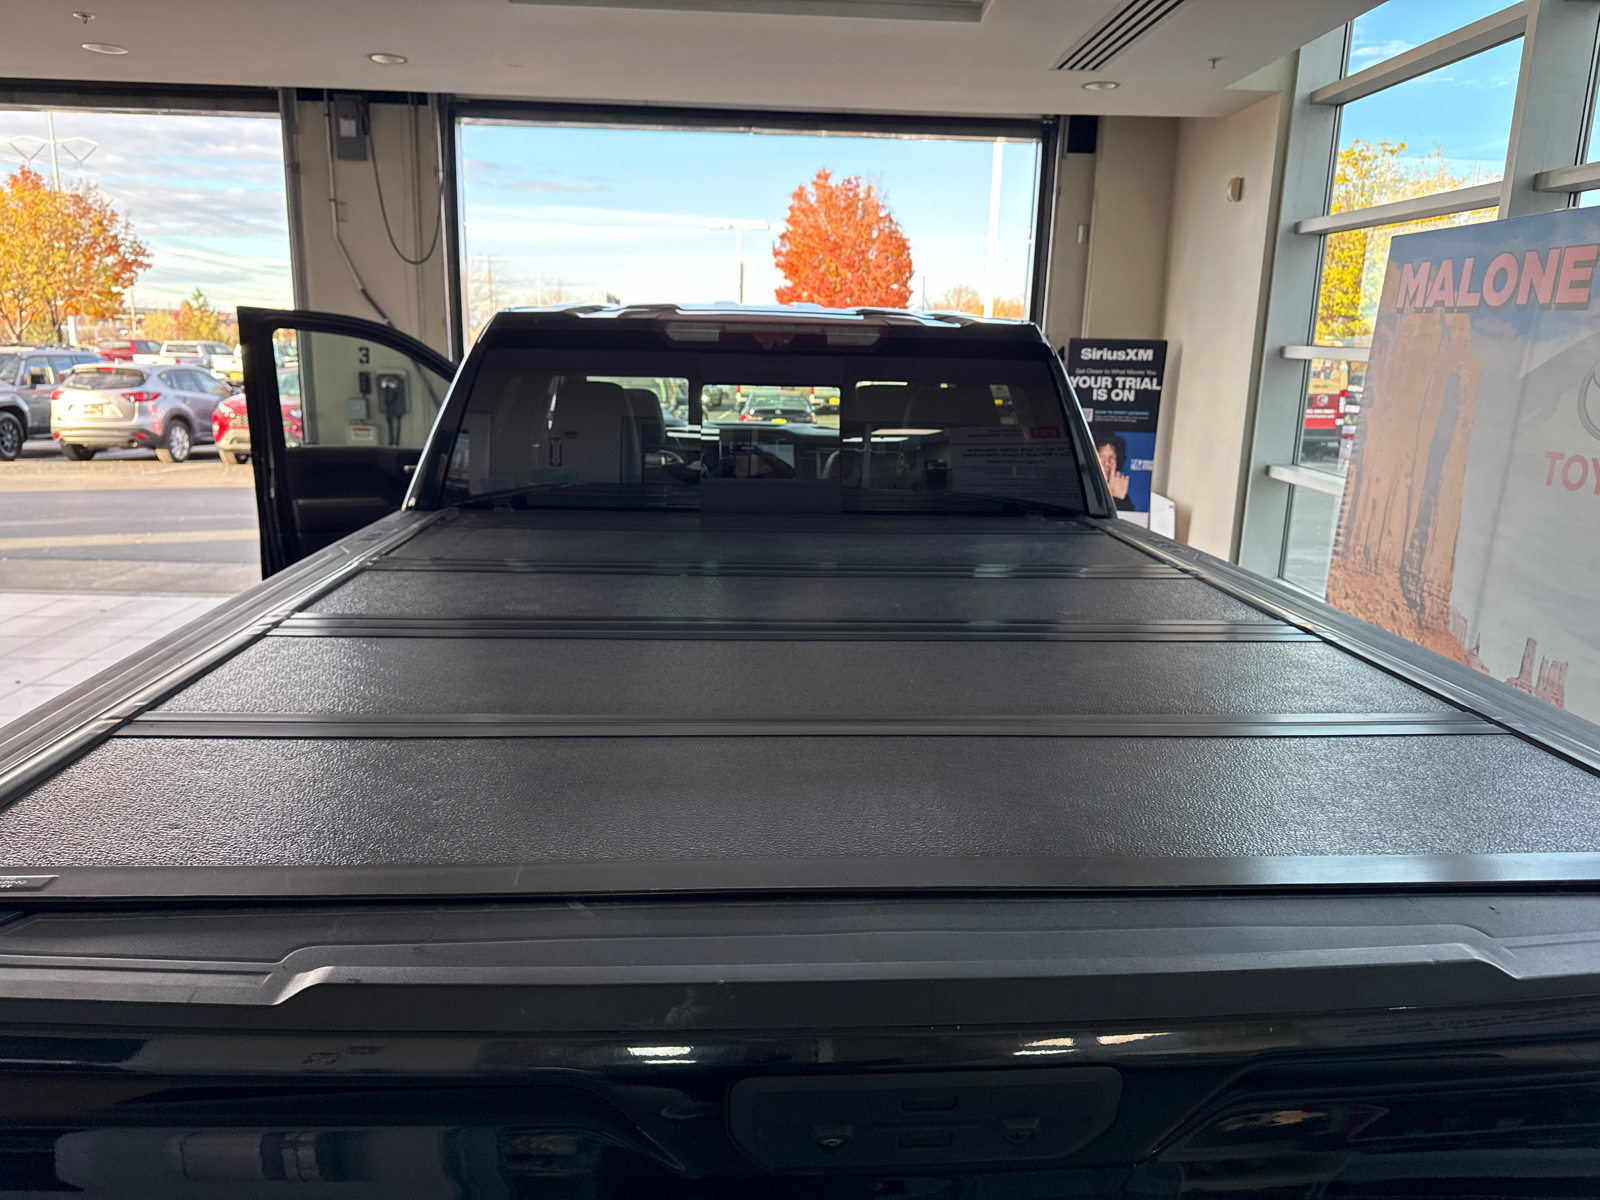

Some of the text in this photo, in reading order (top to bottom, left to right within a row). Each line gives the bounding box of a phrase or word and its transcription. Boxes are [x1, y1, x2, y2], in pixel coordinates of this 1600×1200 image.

[1396, 244, 1599, 312] MALONE
[358, 346, 370, 364] 3
[1080, 347, 1154, 361] SiriusXM
[1070, 376, 1161, 390] YOUR TRIAL
[1092, 388, 1136, 402] IS ON
